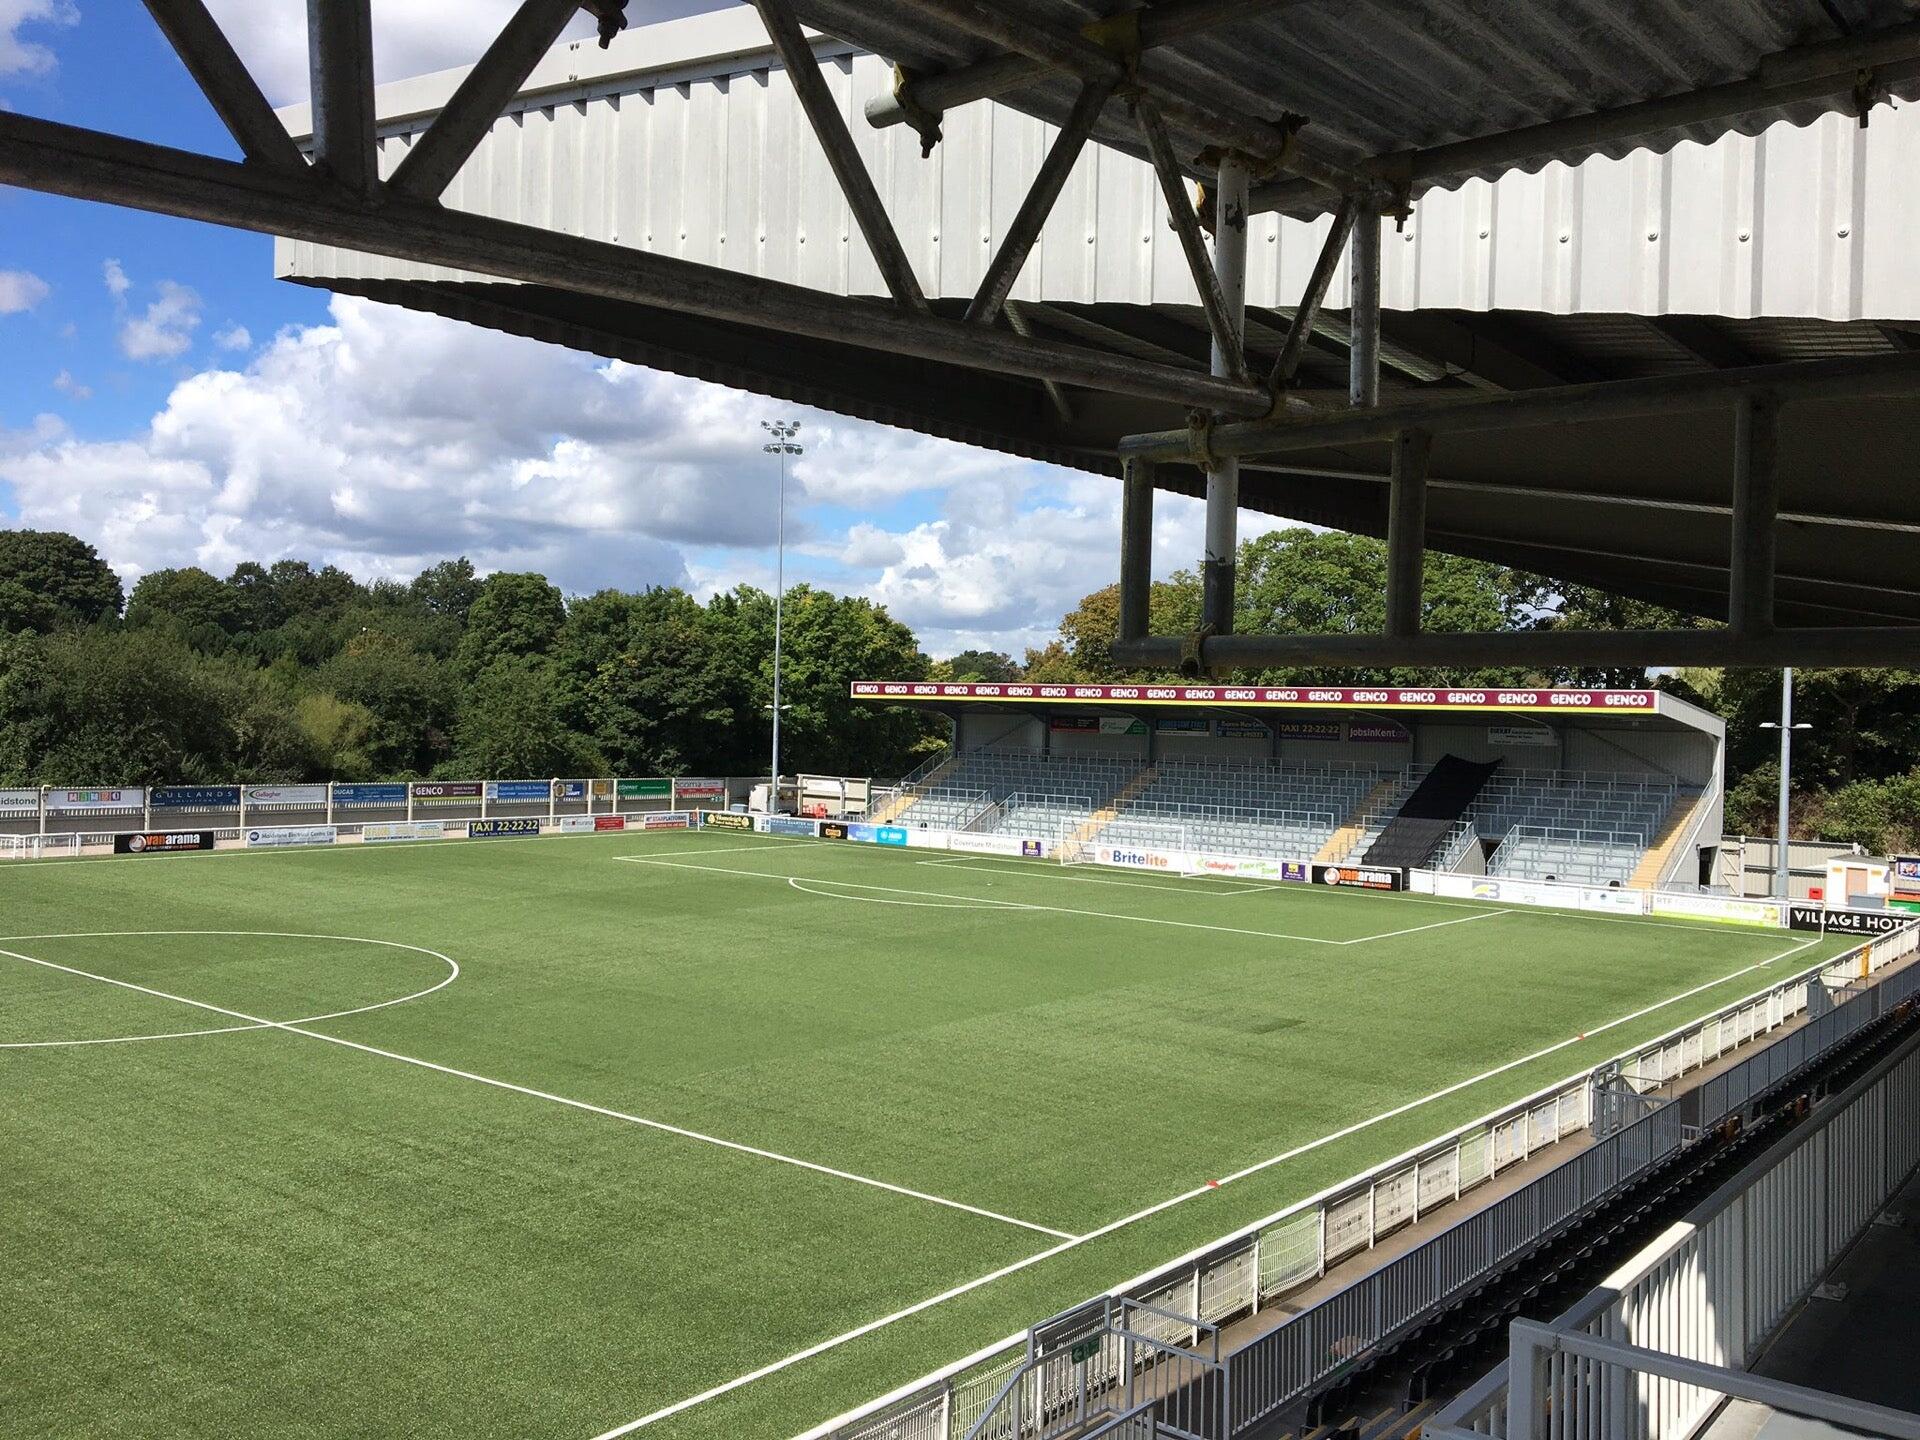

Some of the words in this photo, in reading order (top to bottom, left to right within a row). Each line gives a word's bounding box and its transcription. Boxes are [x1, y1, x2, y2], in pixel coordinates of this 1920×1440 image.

[856, 686, 879, 694] GENCO
[884, 686, 907, 695] GENCO
[914, 686, 938, 695] GENCO
[944, 687, 968, 695] GENCO
[976, 687, 1000, 696] GENCO
[1008, 688, 1033, 696] GENCO
[1041, 688, 1067, 697] GENCO
[1075, 689, 1102, 697] GENCO
[1111, 689, 1138, 698] GENCO
[1147, 689, 1176, 698] GENCO
[1185, 690, 1215, 699] GENCO
[1225, 690, 1255, 700] GENCO
[1266, 691, 1298, 700] GENCO
[1309, 691, 1342, 701] GENCO
[1353, 692, 1387, 702] GENCO
[1400, 693, 1435, 703] GENCO
[1448, 693, 1485, 703] GENCO
[1498, 694, 1537, 704] GENCO
[1551, 694, 1591, 705] GENCO
[1605, 695, 1647, 706] GENCO
[156, 791, 233, 799] GULLANDS
[415, 786, 443, 795] GENCO
[470, 822, 494, 832] TAXI
[146, 834, 200, 845] vanarama
[1113, 850, 1168, 867] Britelite
[1205, 861, 1236, 871] Gallagher
[1340, 868, 1392, 884] vanarama
[1794, 910, 1861, 927] VILLAGE
